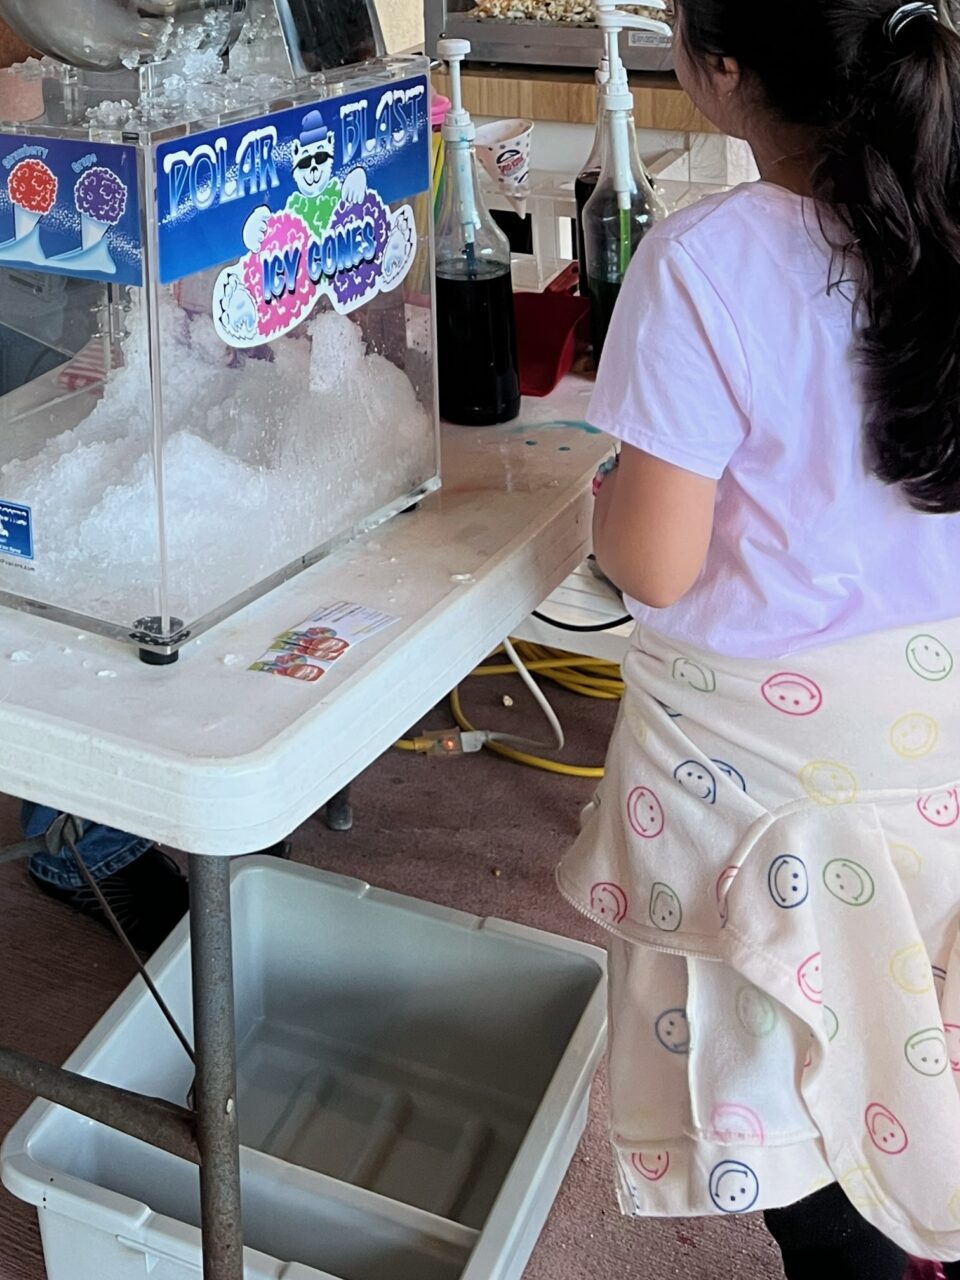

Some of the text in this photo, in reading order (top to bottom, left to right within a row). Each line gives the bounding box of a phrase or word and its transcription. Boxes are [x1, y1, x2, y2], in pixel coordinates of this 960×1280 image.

[163, 84, 425, 217] POLAR BLAST
[262, 219, 377, 305] ICY CONES
